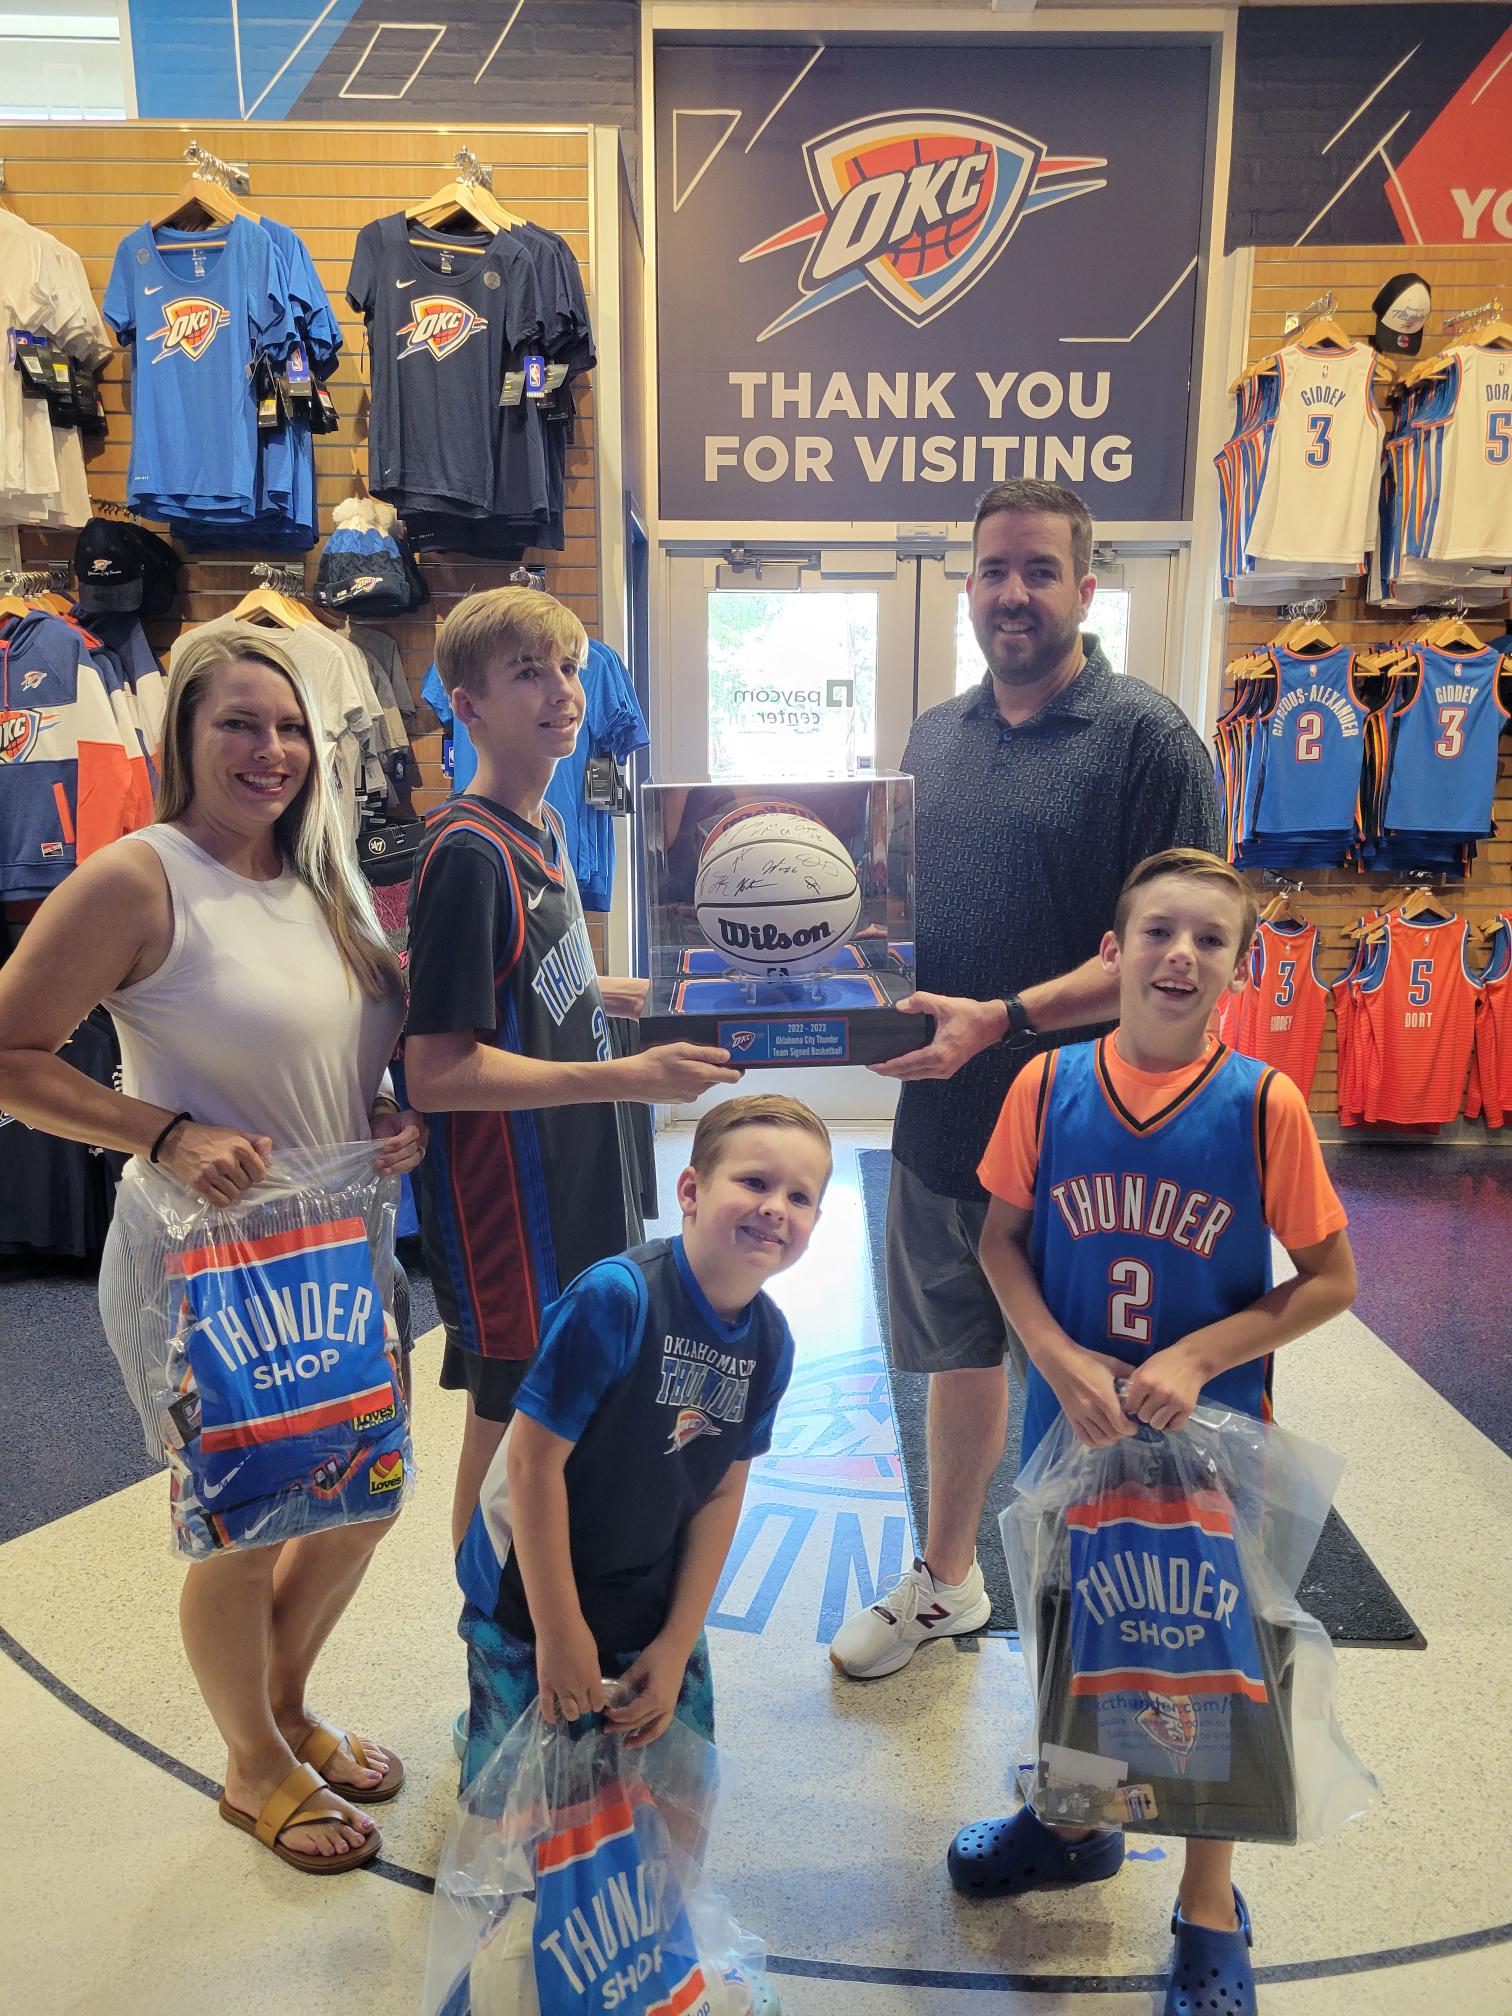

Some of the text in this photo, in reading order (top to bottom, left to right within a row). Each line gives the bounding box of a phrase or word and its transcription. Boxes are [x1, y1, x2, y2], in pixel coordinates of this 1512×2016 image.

[813, 153, 991, 279] OKC
[166, 309, 210, 347] OKC
[412, 311, 462, 343] OKC
[728, 370, 1111, 419] THANK YOU
[1300, 385, 1346, 408] GIDDEY
[1485, 384, 1512, 402] DOR
[704, 434, 1134, 483] FOR VISITING
[1305, 413, 1334, 469] 3
[1484, 409, 1512, 466] 5
[1271, 684, 1360, 738] GILGEOUS-ALEXANDER
[1435, 684, 1479, 705] GIDDEY
[0, 716, 26, 752] KC
[1295, 710, 1323, 763] 2
[1434, 707, 1468, 760] 3
[717, 917, 832, 950] Wilson
[1274, 960, 1297, 1007] 3
[1408, 958, 1435, 1007] 5
[787, 1023, 804, 1033] 2022
[810, 1023, 827, 1032] 2023
[804, 1035, 815, 1045] City
[1404, 1012, 1434, 1028] DORT
[773, 1046, 843, 1057] Team Signed Basketball
[1051, 1172, 1235, 1259] THUNDER
[1108, 1257, 1153, 1344] 2
[195, 1281, 373, 1372] THUNDER
[253, 1348, 340, 1390] SHOP
[663, 1335, 737, 1376] OKLAHOMA
[1076, 1550, 1240, 1630] THUNDER
[1119, 1620, 1206, 1649] SHOP
